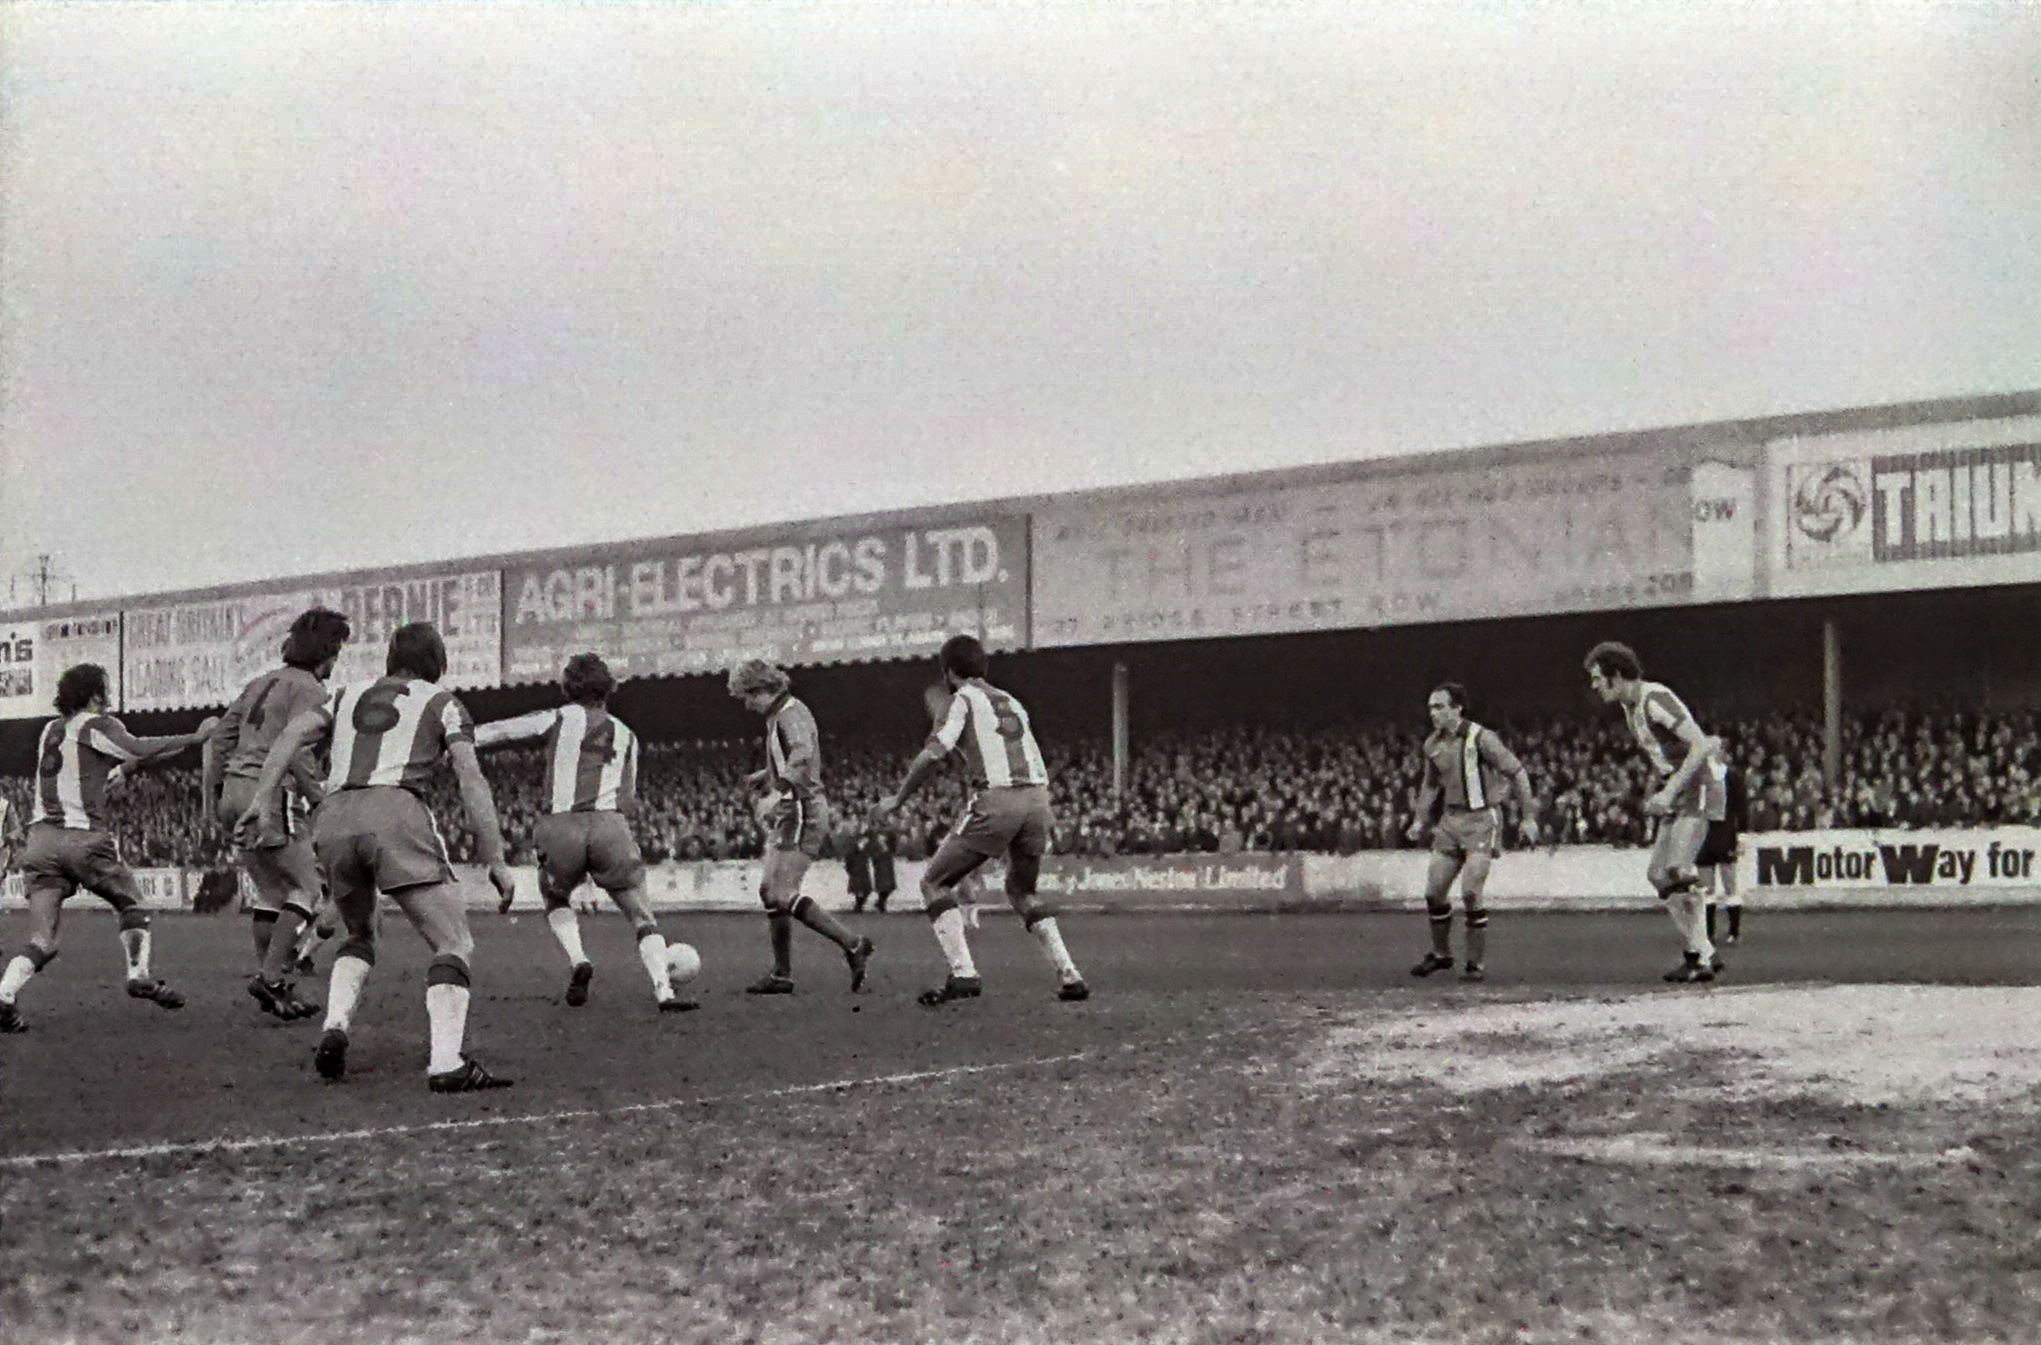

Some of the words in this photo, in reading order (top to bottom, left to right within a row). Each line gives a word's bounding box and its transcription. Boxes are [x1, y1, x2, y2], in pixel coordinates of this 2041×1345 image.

[903, 525, 1009, 589] LTD.
[352, 684, 410, 735] 6
[1987, 840, 2035, 879] for
